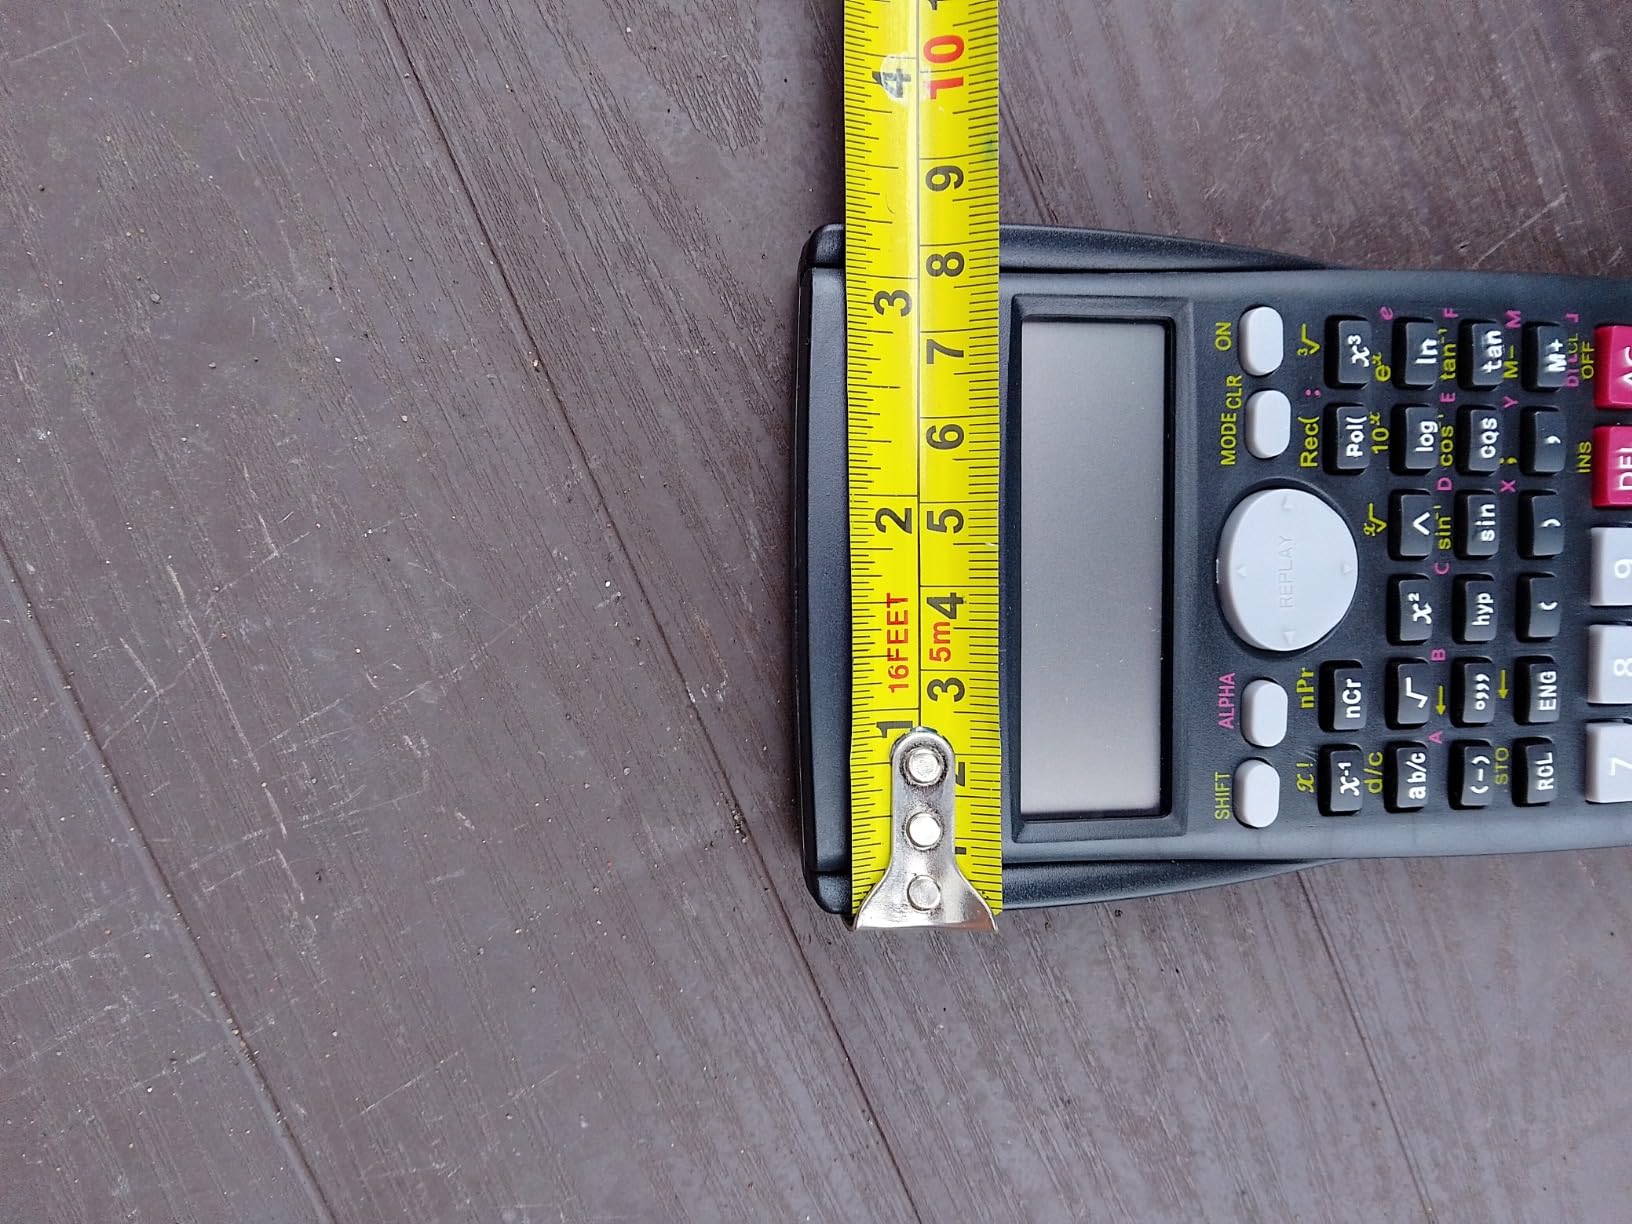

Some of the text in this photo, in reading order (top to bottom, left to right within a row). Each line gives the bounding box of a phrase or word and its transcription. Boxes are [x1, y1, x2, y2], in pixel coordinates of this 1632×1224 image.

[923, 34, 965, 100] 10
[872, 68, 911, 98] 4
[925, 165, 964, 192] 9
[926, 251, 965, 277] 8
[874, 290, 912, 317] 3
[1443, 308, 1459, 318] F
[1505, 309, 1522, 329] M
[926, 338, 965, 365] 7
[1215, 321, 1232, 352] ON
[1484, 330, 1503, 373] tan
[1545, 338, 1567, 373] M+
[1580, 341, 1595, 380] OFF
[1440, 392, 1456, 403] E
[1503, 396, 1519, 409] Y
[1220, 374, 1243, 466] MODE CLR
[926, 423, 965, 450] 6
[1415, 420, 1438, 453] log
[1576, 441, 1592, 473] INS
[1437, 477, 1453, 492] D
[1500, 479, 1517, 493] X
[875, 507, 912, 534] 2
[926, 508, 965, 534] 5
[1481, 503, 1496, 543] sin
[1279, 536, 1295, 609] REPLAY
[1434, 562, 1450, 575] C
[926, 592, 965, 619] 4
[1472, 592, 1495, 626] hyp
[928, 621, 951, 662] 5m
[1430, 648, 1446, 661] B
[927, 677, 965, 702] 3
[1218, 672, 1236, 730] ALPHA
[1296, 667, 1316, 710] nPr
[1344, 678, 1363, 719] nCr
[1537, 670, 1557, 712] ENG
[876, 720, 913, 738] 1
[1428, 730, 1444, 745] A
[1363, 750, 1384, 794] d/c
[1494, 746, 1510, 786] STO
[1537, 751, 1555, 792] RCL
[1608, 758, 1632, 777] 7
[1214, 771, 1232, 821] SHIFT
